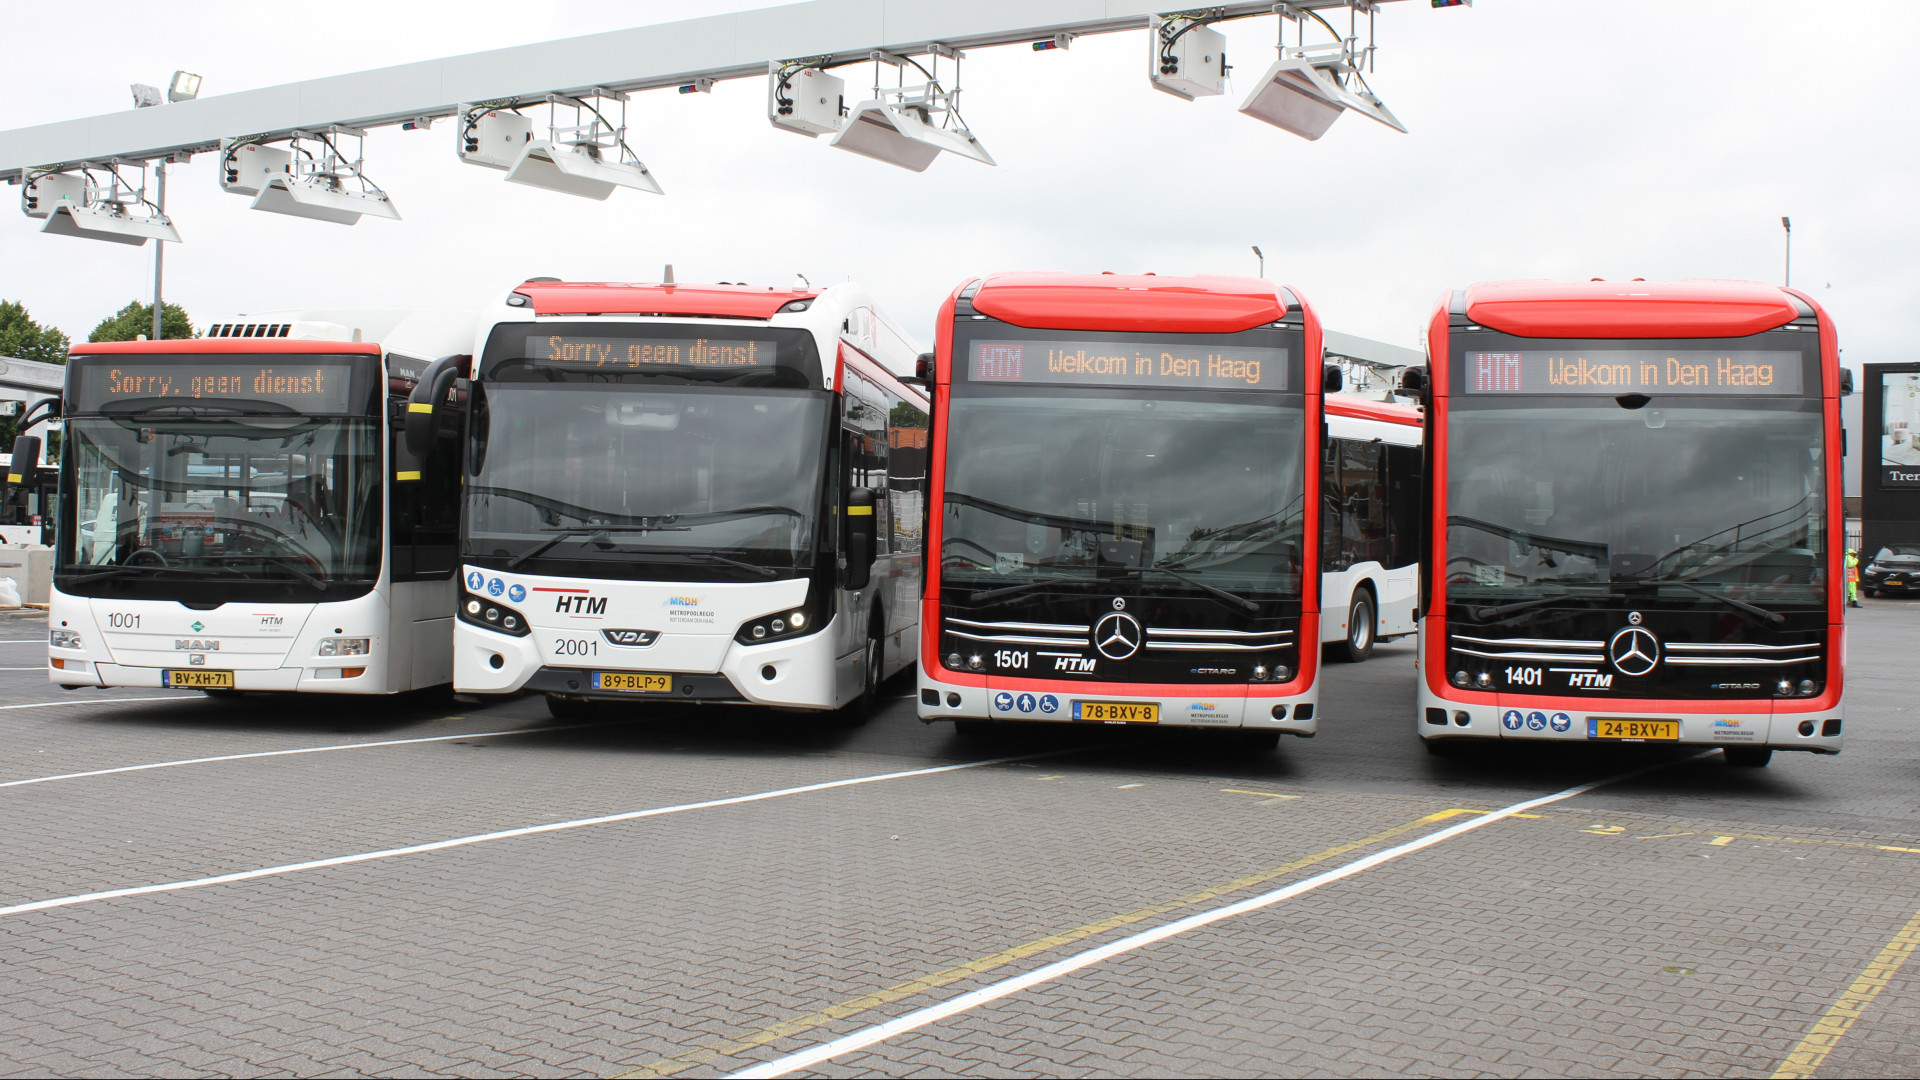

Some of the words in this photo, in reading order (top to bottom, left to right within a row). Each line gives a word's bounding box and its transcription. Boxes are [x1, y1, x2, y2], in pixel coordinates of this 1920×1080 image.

[549, 335, 618, 366] Sorry,
[628, 344, 679, 367] geen
[689, 338, 757, 365] dienst
[981, 346, 1023, 378] HTM
[1048, 349, 1127, 375] Welkom
[1135, 352, 1152, 376] in
[1160, 352, 1200, 377] Den
[1208, 354, 1261, 384] Haag
[1478, 353, 1519, 391] HTM
[1549, 357, 1632, 386] Welkom
[1640, 360, 1658, 386] in
[1666, 357, 1709, 386] Den
[1717, 357, 1773, 386] Haag
[400, 367, 415, 378] MAN
[110, 369, 180, 399] Sorry,
[191, 376, 241, 399] geen
[253, 369, 325, 394] dienst
[555, 595, 608, 615] HTM
[669, 596, 698, 606] MRDH
[108, 612, 141, 629] 1001
[261, 616, 284, 625] HTM
[609, 631, 651, 643] VDL
[175, 639, 220, 650] MAN
[555, 638, 598, 656] 2001
[994, 650, 1029, 669] 1501
[1054, 657, 1097, 671] HTM
[175, 672, 227, 685] BV-XH-71
[604, 675, 666, 689] 89-BLP-9
[1504, 666, 1542, 686] 1401
[1568, 673, 1613, 687] HTM
[1086, 705, 1152, 719] 78-BXV-8
[1604, 722, 1670, 737] 24-BXV-1
